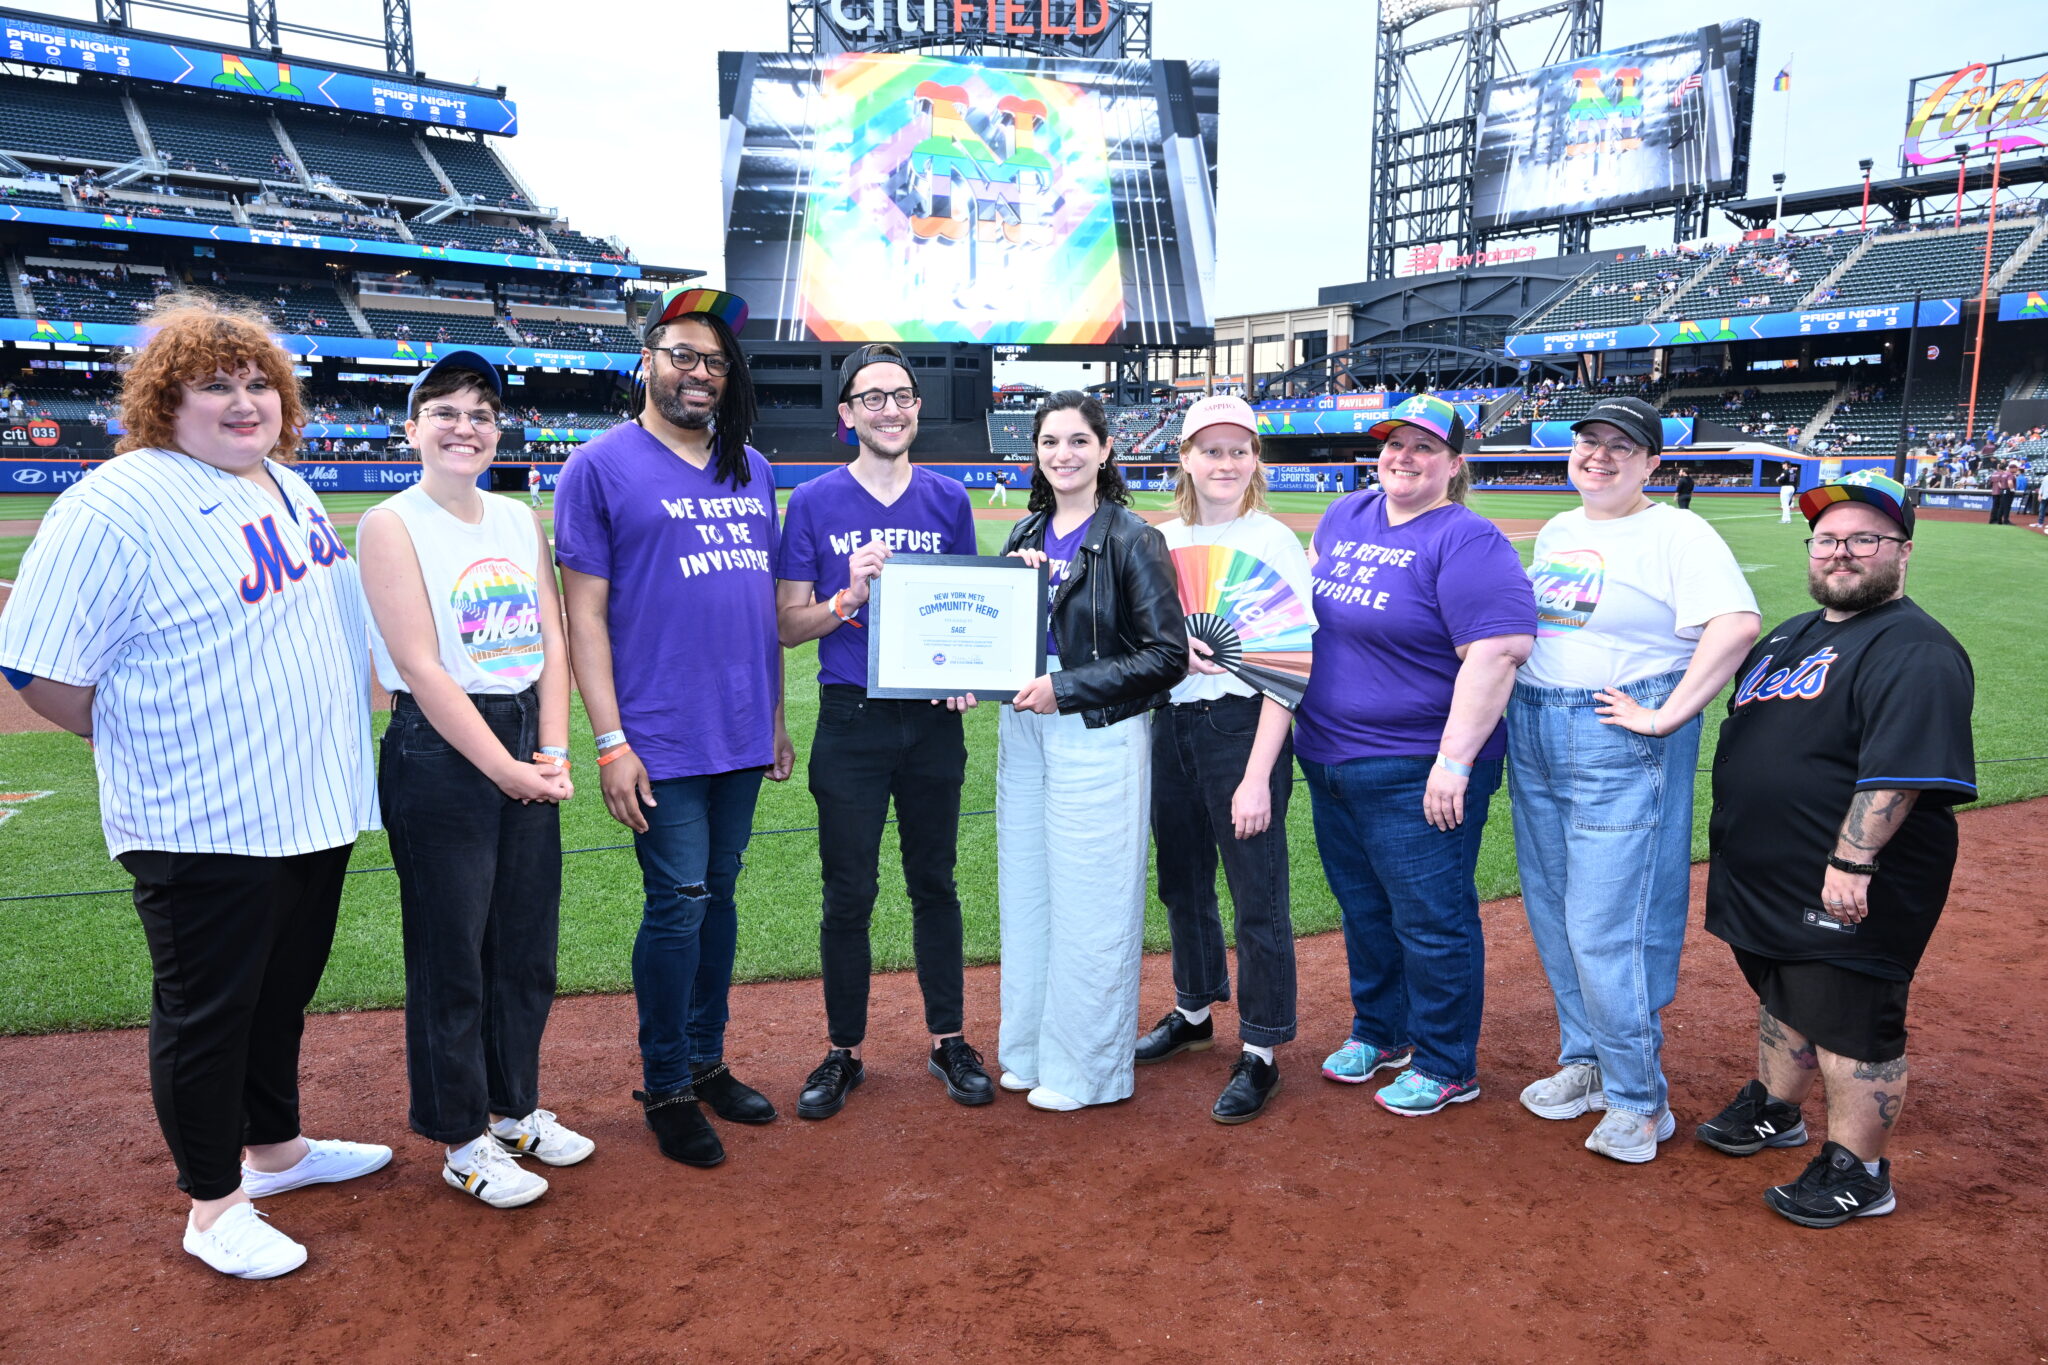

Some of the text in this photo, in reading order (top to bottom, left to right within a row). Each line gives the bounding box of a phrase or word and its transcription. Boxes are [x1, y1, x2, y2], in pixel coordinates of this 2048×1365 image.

[954, 0, 1109, 35] FIELD
[6, 28, 131, 57] PRIDE NIGHT
[372, 87, 467, 110] PRIDE NIGHT
[250, 228, 320, 242] PRIDE NIGHT
[1446, 253, 1474, 268] new
[1476, 245, 1537, 264] balance
[1800, 307, 1900, 324] PRIDE NIGHT
[1543, 330, 1618, 344] PRIDE NIGHT
[534, 352, 586, 361] PRIDE NIGHT
[1318, 398, 1334, 409] citi
[1339, 399, 1381, 408] PAVILION
[1353, 411, 1390, 421] PRIDE
[2, 427, 27, 440] citi
[32, 427, 56, 438] 035
[309, 466, 339, 480] Mets
[1281, 473, 1330, 482] SPORTSBK
[1127, 481, 1142, 489] 380
[661, 497, 767, 519] WE REFUSE
[695, 523, 752, 545] TO BE
[829, 528, 942, 555] WE REFUSE
[1330, 540, 1416, 568] WE REFUSE
[679, 548, 769, 578] INVISIBLE
[1330, 561, 1378, 584] TO BE
[934, 591, 985, 602] NEW YORK METS
[919, 601, 999, 619] COMMUNITY HERO
[472, 600, 539, 645] Mets
